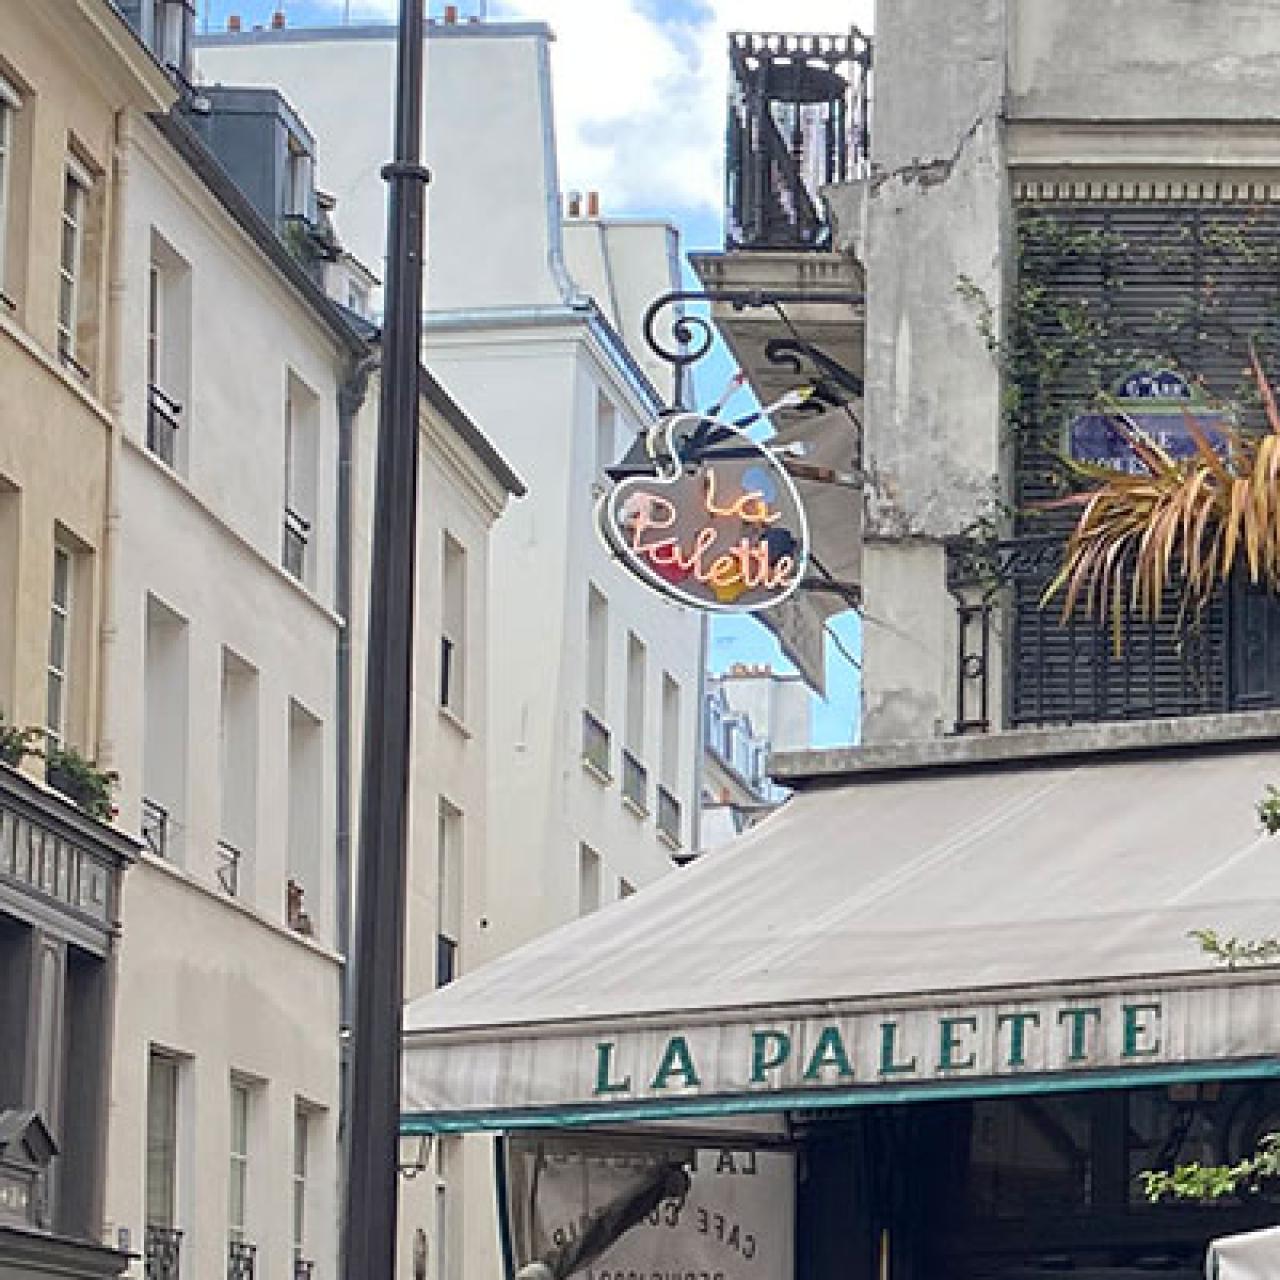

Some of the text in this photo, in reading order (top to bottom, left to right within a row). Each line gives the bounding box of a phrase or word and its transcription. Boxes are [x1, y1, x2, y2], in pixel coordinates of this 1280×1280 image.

[632, 491, 796, 588] Palette
[705, 468, 782, 523] La
[594, 1003, 1163, 1095] LA PALETTE
